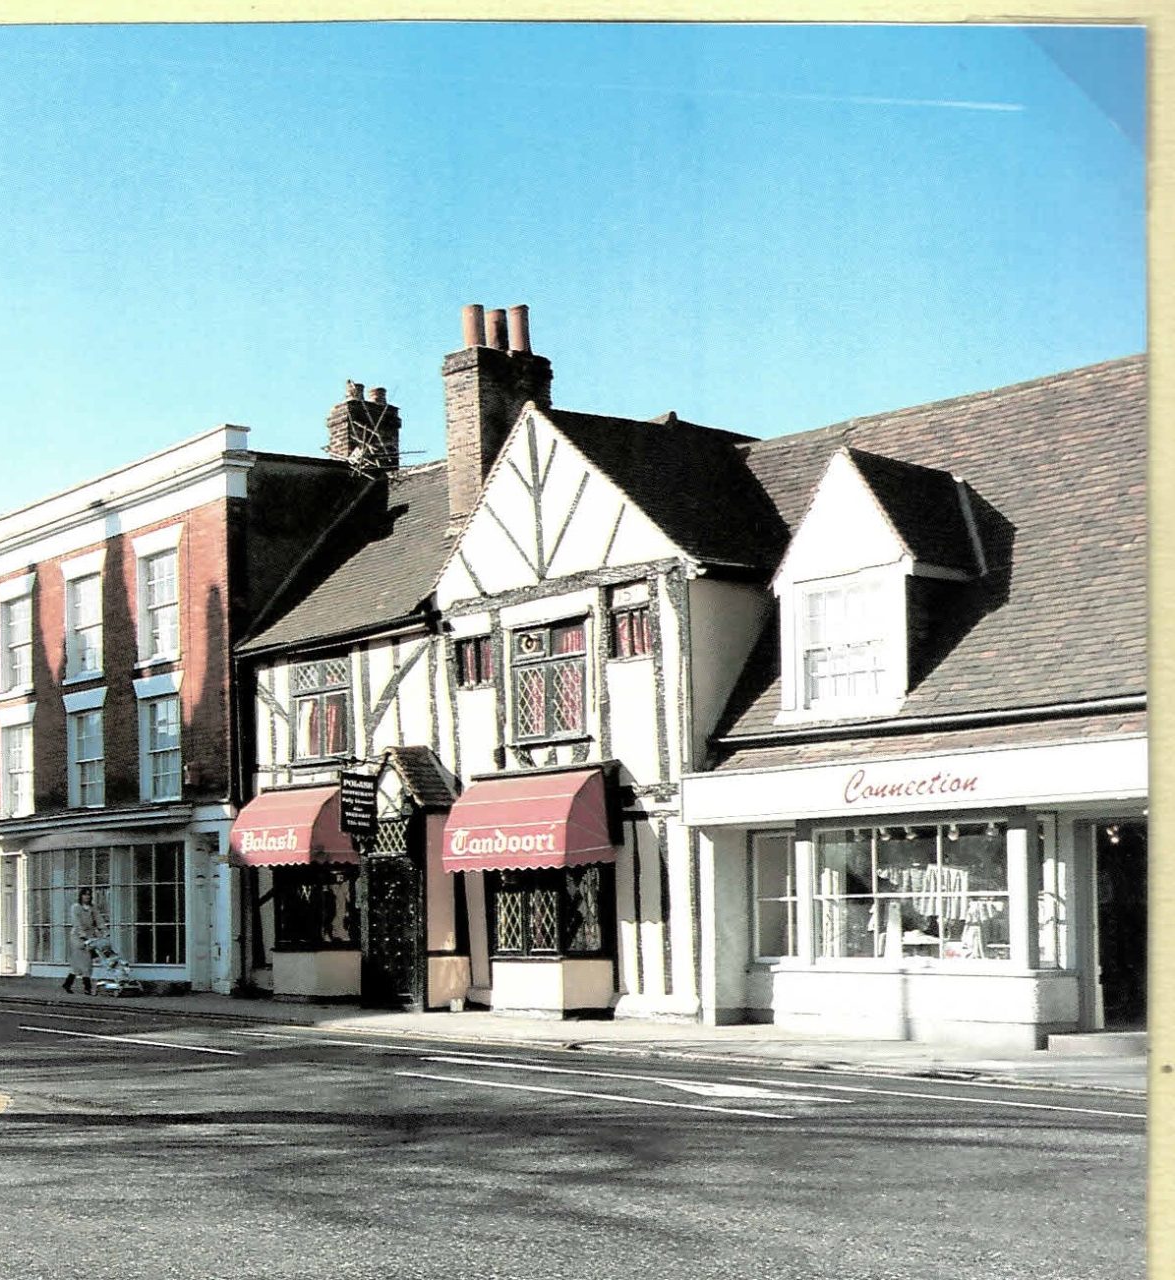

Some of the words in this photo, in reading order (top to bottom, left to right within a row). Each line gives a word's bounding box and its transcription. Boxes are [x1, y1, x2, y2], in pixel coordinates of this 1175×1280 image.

[844, 769, 978, 804] Connection
[241, 828, 298, 854] Polash
[450, 824, 556, 856] Tandoori
